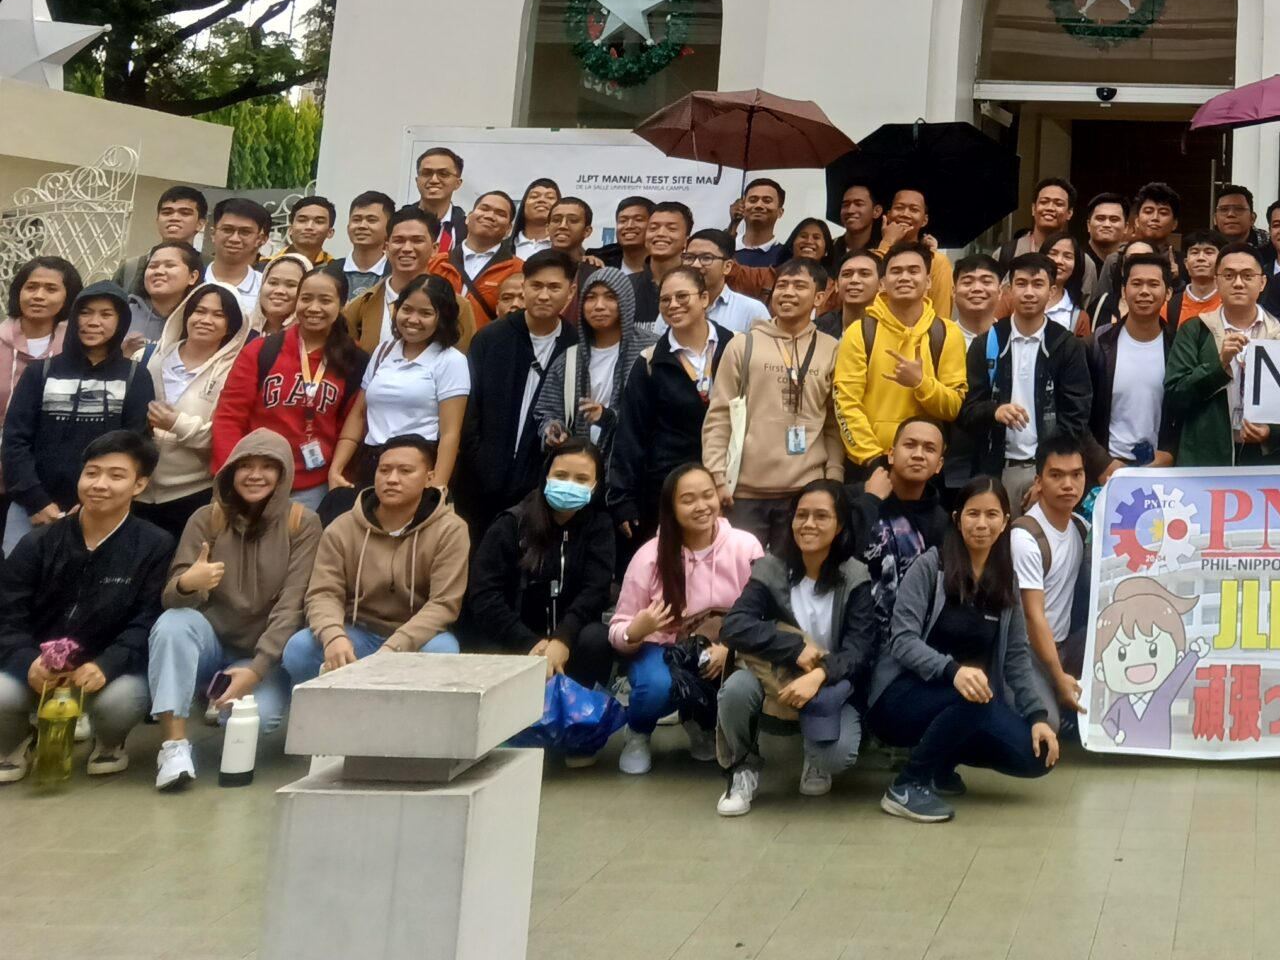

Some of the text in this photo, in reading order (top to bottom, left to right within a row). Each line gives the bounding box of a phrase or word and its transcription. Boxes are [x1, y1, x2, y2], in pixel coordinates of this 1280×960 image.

[576, 174, 600, 183] JLPT
[602, 175, 642, 184] MANILA
[646, 175, 670, 184] TEST
[672, 176, 693, 185] SITE
[763, 363, 784, 373] First
[263, 372, 339, 414] GAP
